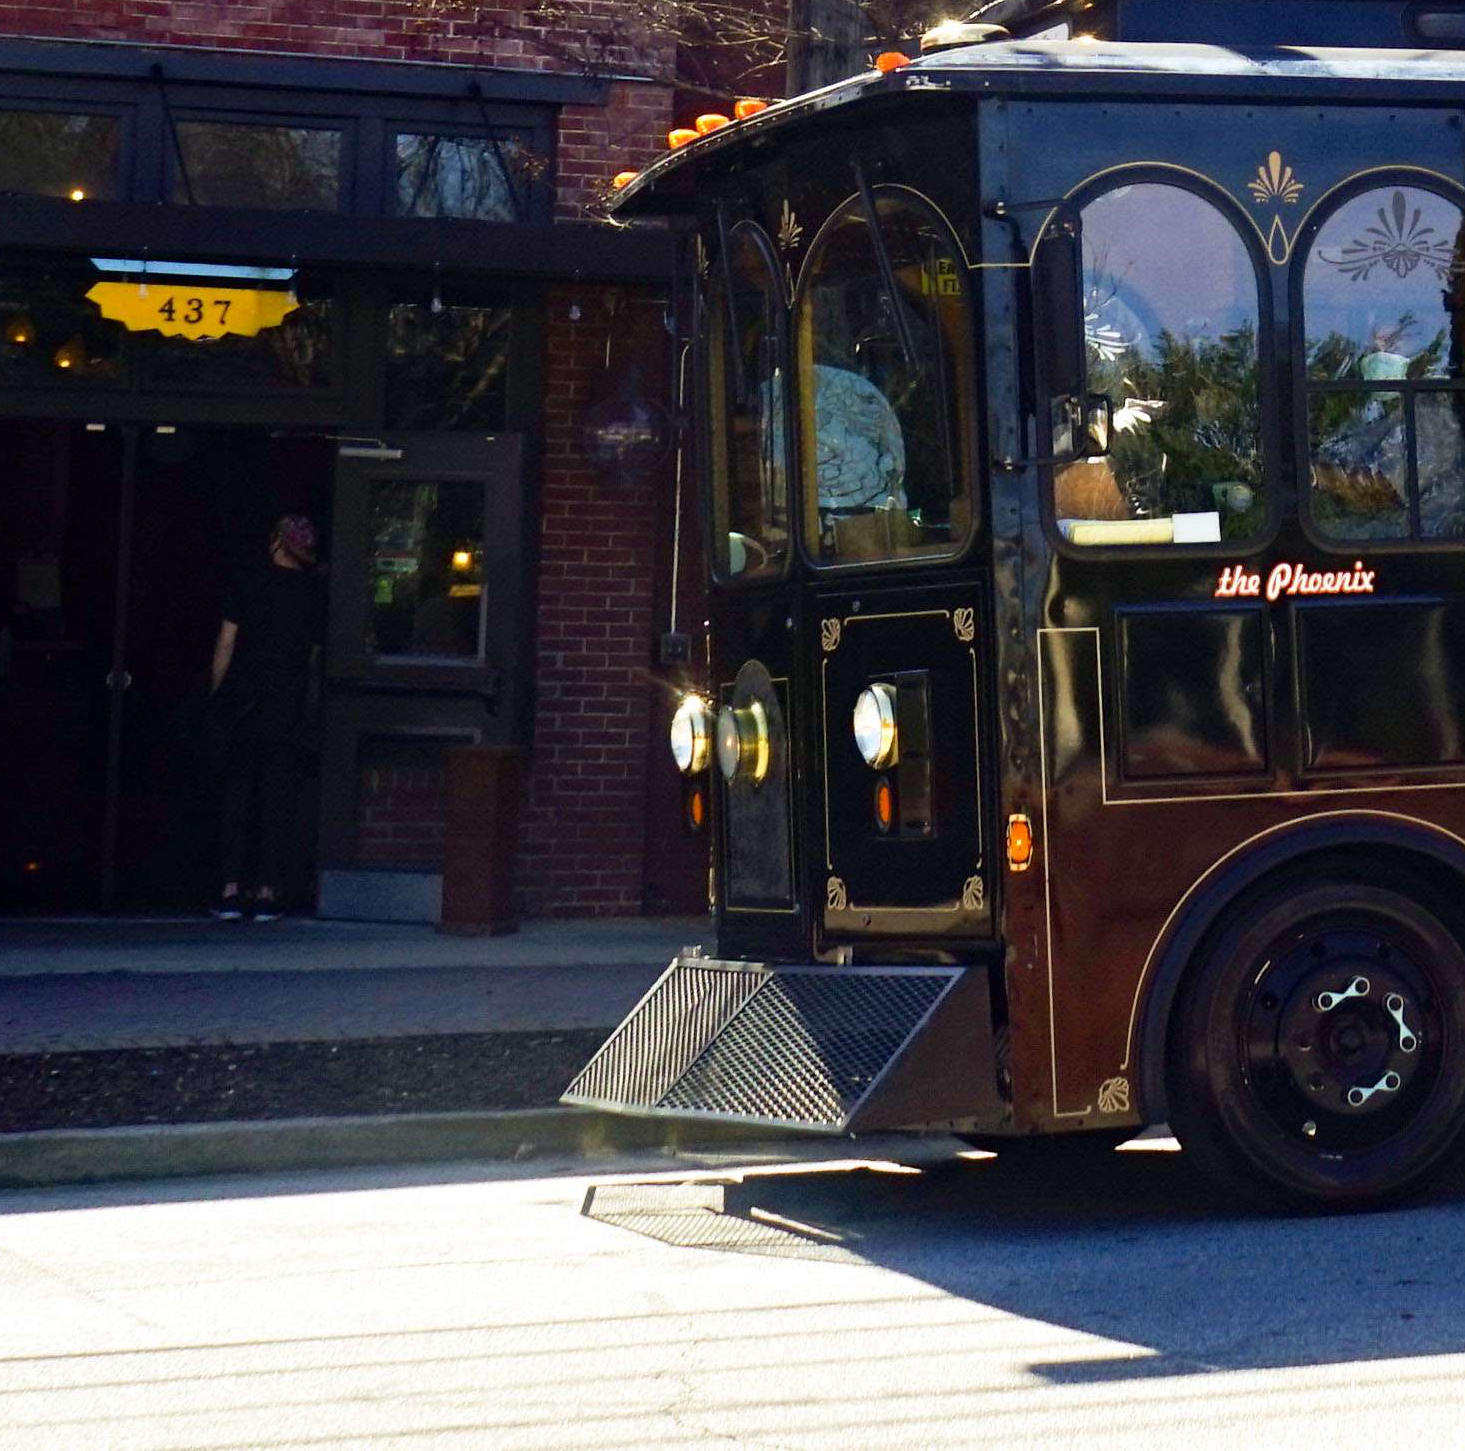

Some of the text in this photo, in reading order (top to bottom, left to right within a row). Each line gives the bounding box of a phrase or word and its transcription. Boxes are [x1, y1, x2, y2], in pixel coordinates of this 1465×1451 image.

[157, 297, 231, 325] 437
[1214, 560, 1376, 603] the Phoenix
